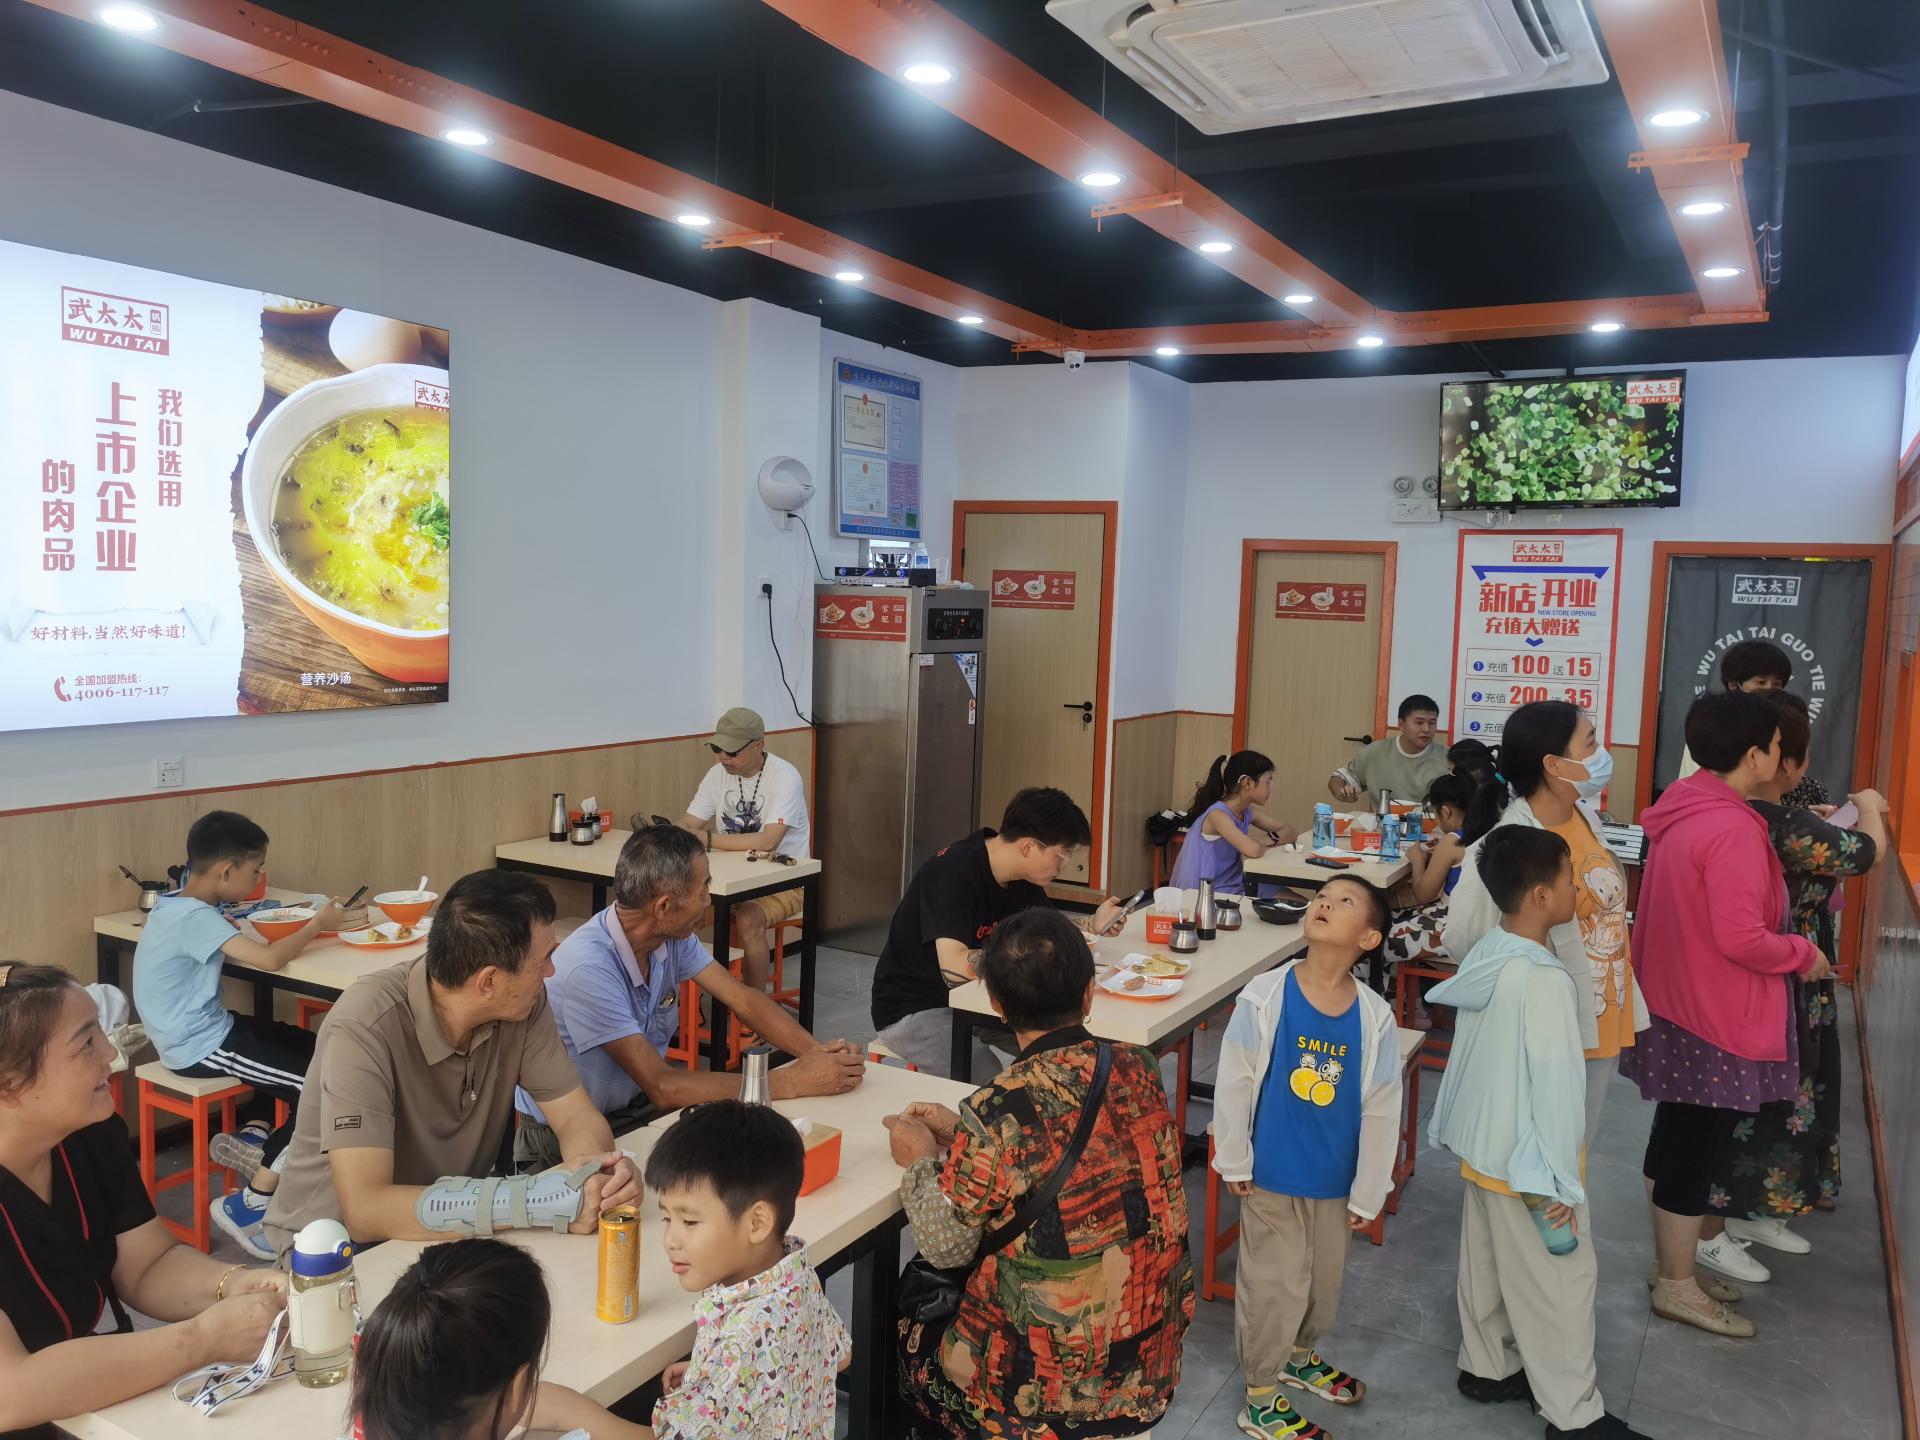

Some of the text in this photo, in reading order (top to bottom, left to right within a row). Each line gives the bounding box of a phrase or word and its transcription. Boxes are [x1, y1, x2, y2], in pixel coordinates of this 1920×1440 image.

[67, 297, 144, 331] 武太太
[69, 327, 161, 352] WU TAI TAI
[158, 388, 182, 507] 我们选用
[96, 382, 136, 571] 上市企业
[42, 458, 75, 571] 的肉品
[1516, 543, 1551, 553] 武太太
[1479, 579, 1597, 613] 新店开业
[1737, 579, 1782, 593] 武太太
[1485, 617, 1580, 636] 充值大赠送
[1487, 662, 1508, 672] 充值
[1512, 655, 1550, 675] 100
[1553, 665, 1564, 675] 送
[1566, 657, 1592, 677] 15
[1697, 650, 1716, 675] WU
[1715, 630, 1744, 650] TAI
[1749, 627, 1776, 639] TAI
[1781, 633, 1814, 661] GUO
[1810, 665, 1825, 691] TIE
[300, 671, 352, 686] 营养沙汤
[74, 686, 169, 701] 4006-117-117
[1485, 693, 1506, 703] 充值
[1510, 686, 1548, 704] 200
[1565, 688, 1592, 708] 35
[1483, 723, 1504, 733] 充值
[1297, 1035, 1347, 1057] SMILE
